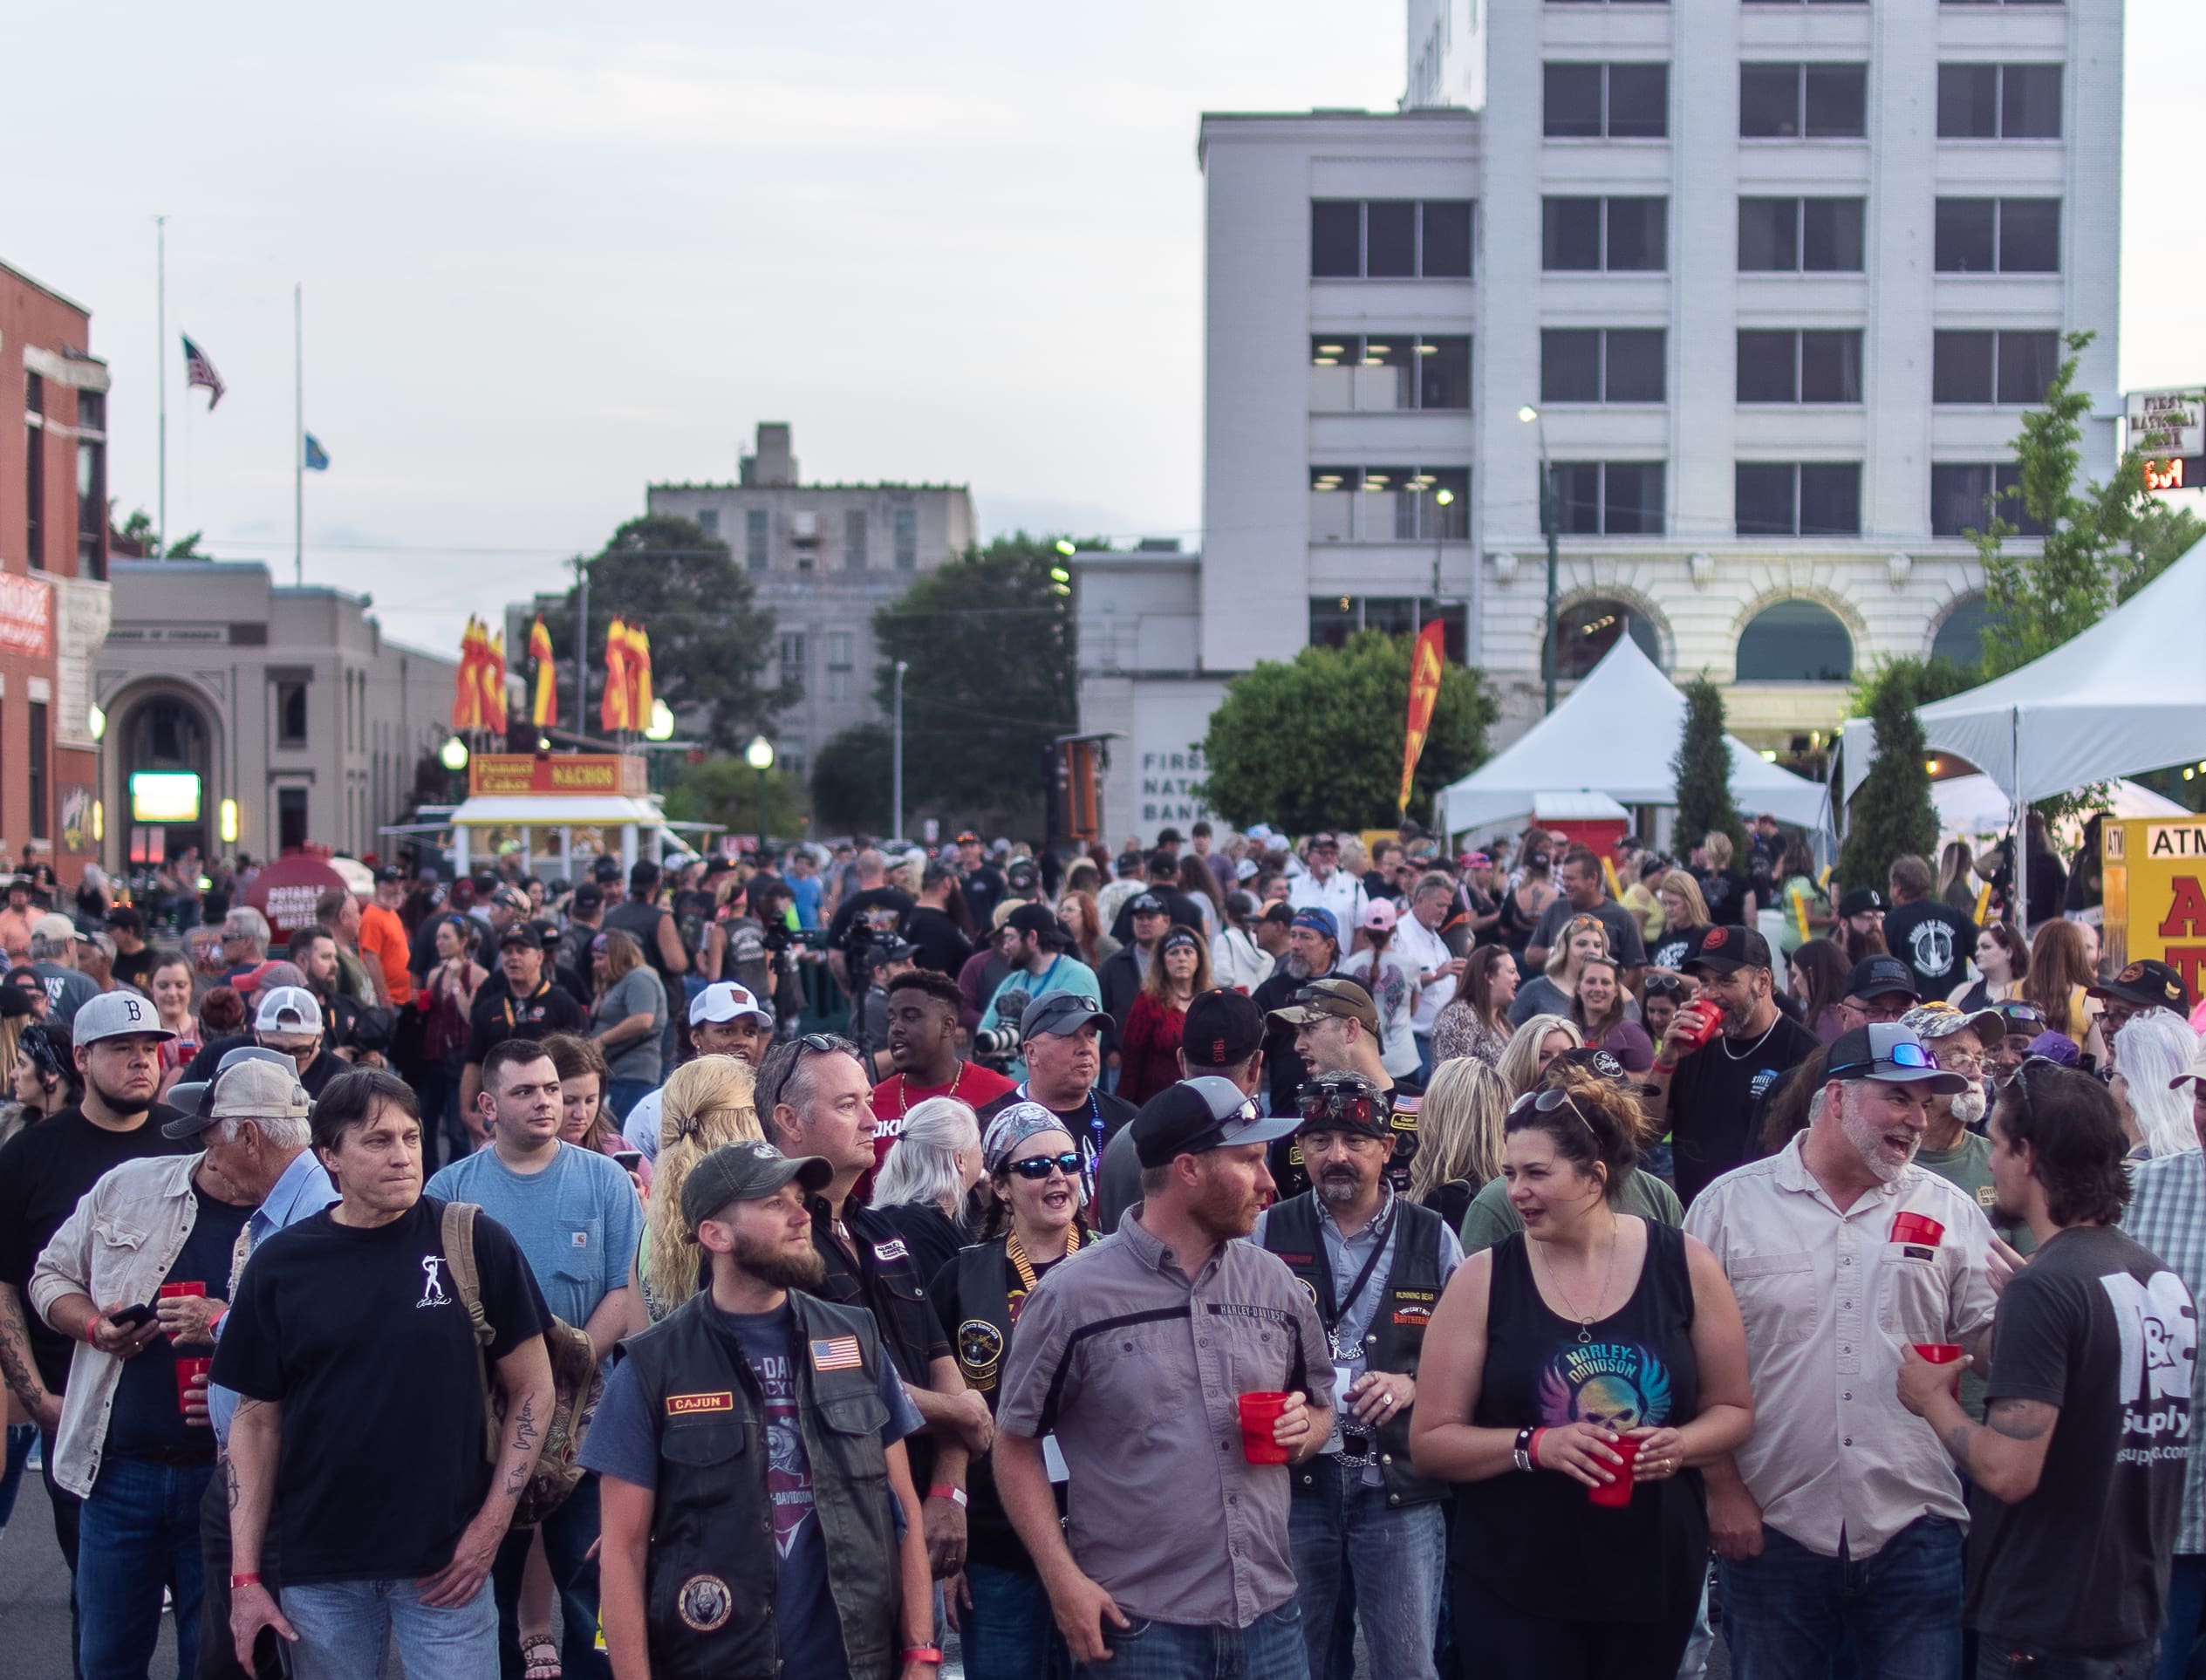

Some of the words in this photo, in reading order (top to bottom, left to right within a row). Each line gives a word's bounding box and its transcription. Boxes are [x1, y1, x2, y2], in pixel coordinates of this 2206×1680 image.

[1143, 753, 1200, 769] FIRS
[552, 765, 613, 784] NACHOS
[2107, 830, 2124, 855] ATM
[124, 1000, 141, 1021] B
[1220, 1305, 1286, 1321] HARLEY-DAVIDSO
[1566, 1344, 1637, 1366] HARLEY-
[1568, 1358, 1637, 1384] DAVIDSON
[675, 1397, 721, 1410] CAJUN
